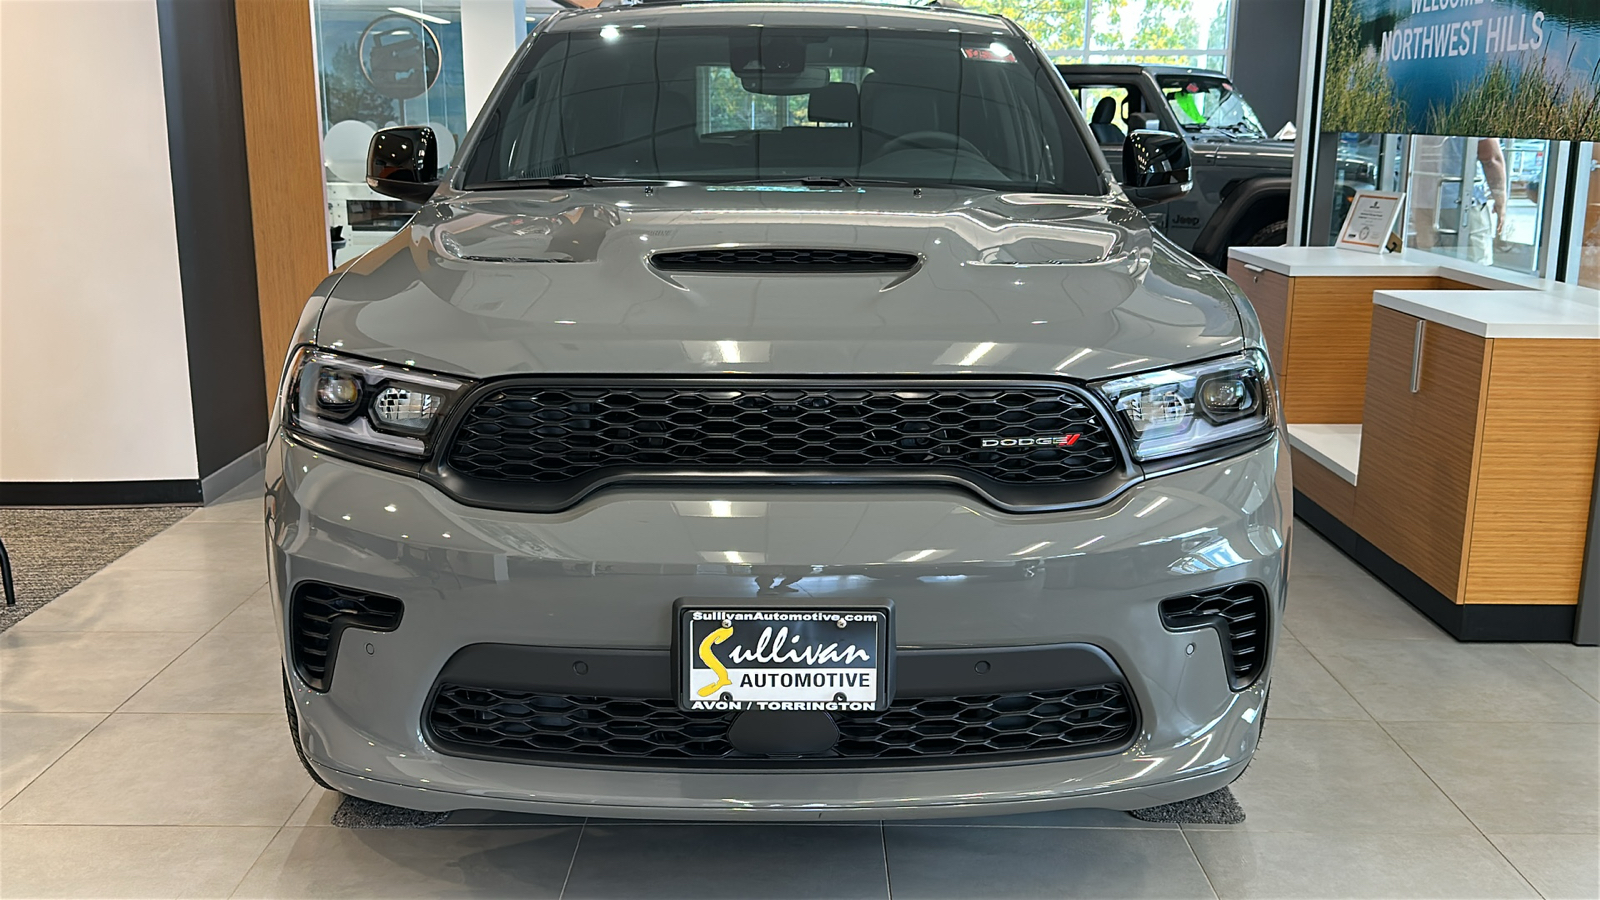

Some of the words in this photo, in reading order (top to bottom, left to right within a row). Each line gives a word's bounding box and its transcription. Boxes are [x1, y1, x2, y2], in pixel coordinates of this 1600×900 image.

[1380, 20, 1483, 62] NORTHWEST
[1486, 11, 1545, 53] HILLS
[1172, 214, 1200, 226] Jeep
[982, 437, 1068, 447] DODGE
[692, 611, 877, 622] SullivanAutomotive.com
[697, 626, 870, 697] Sullivan
[740, 673, 870, 688] AUTOMOTIVE
[691, 702, 742, 710] AVON
[756, 702, 876, 711] TORRINGTON
